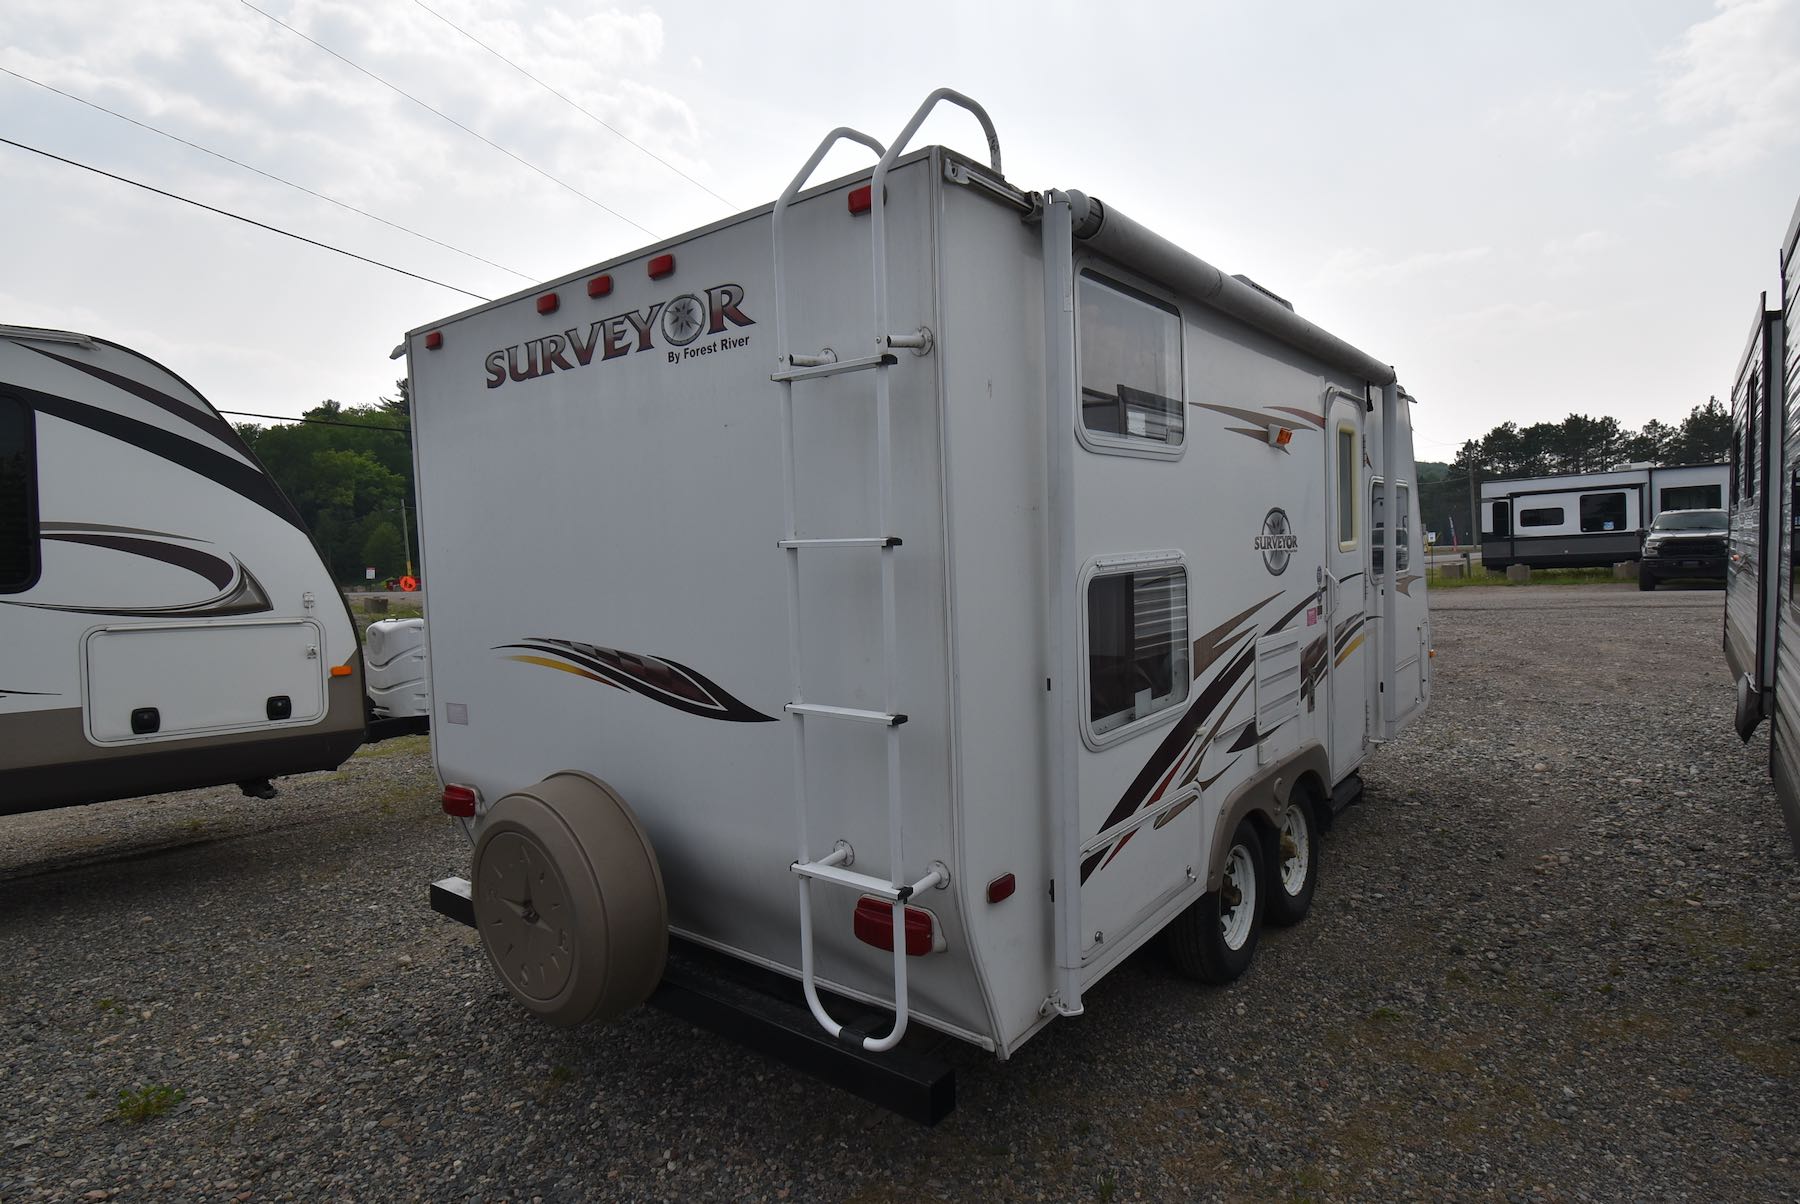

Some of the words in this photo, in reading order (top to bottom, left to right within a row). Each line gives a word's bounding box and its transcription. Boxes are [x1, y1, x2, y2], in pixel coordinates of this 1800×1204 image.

[485, 284, 757, 389] SURVEYOR
[667, 351, 681, 364] By
[683, 343, 717, 360] Forest
[720, 336, 750, 352] River
[1254, 536, 1298, 550] SURVEYOR
